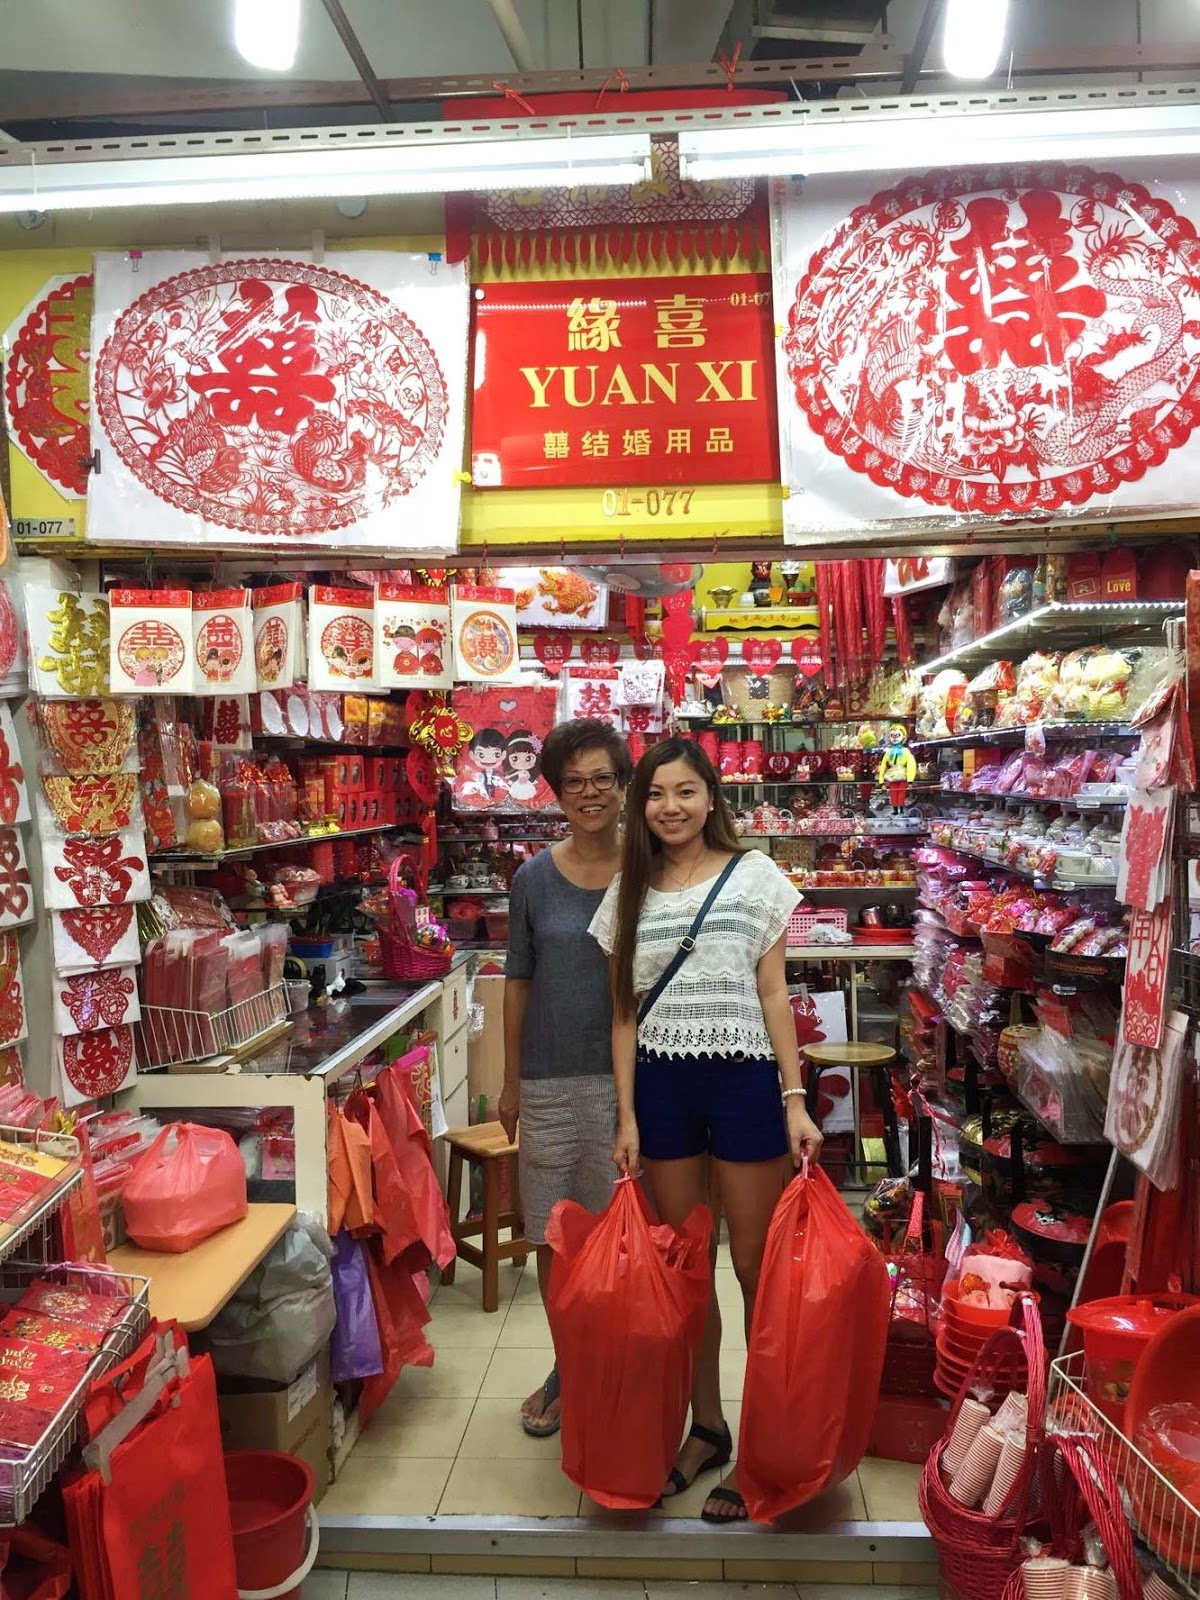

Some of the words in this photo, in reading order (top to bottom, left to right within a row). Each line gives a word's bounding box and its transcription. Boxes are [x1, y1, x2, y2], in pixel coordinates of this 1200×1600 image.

[566, 293, 708, 352] 緣喜
[519, 363, 680, 408] YUAN
[695, 359, 757, 402] XI
[543, 427, 734, 459] 囍结婚用品
[602, 487, 695, 516] 01-077
[16, 521, 63, 535] 01-077
[1107, 581, 1131, 593] Love
